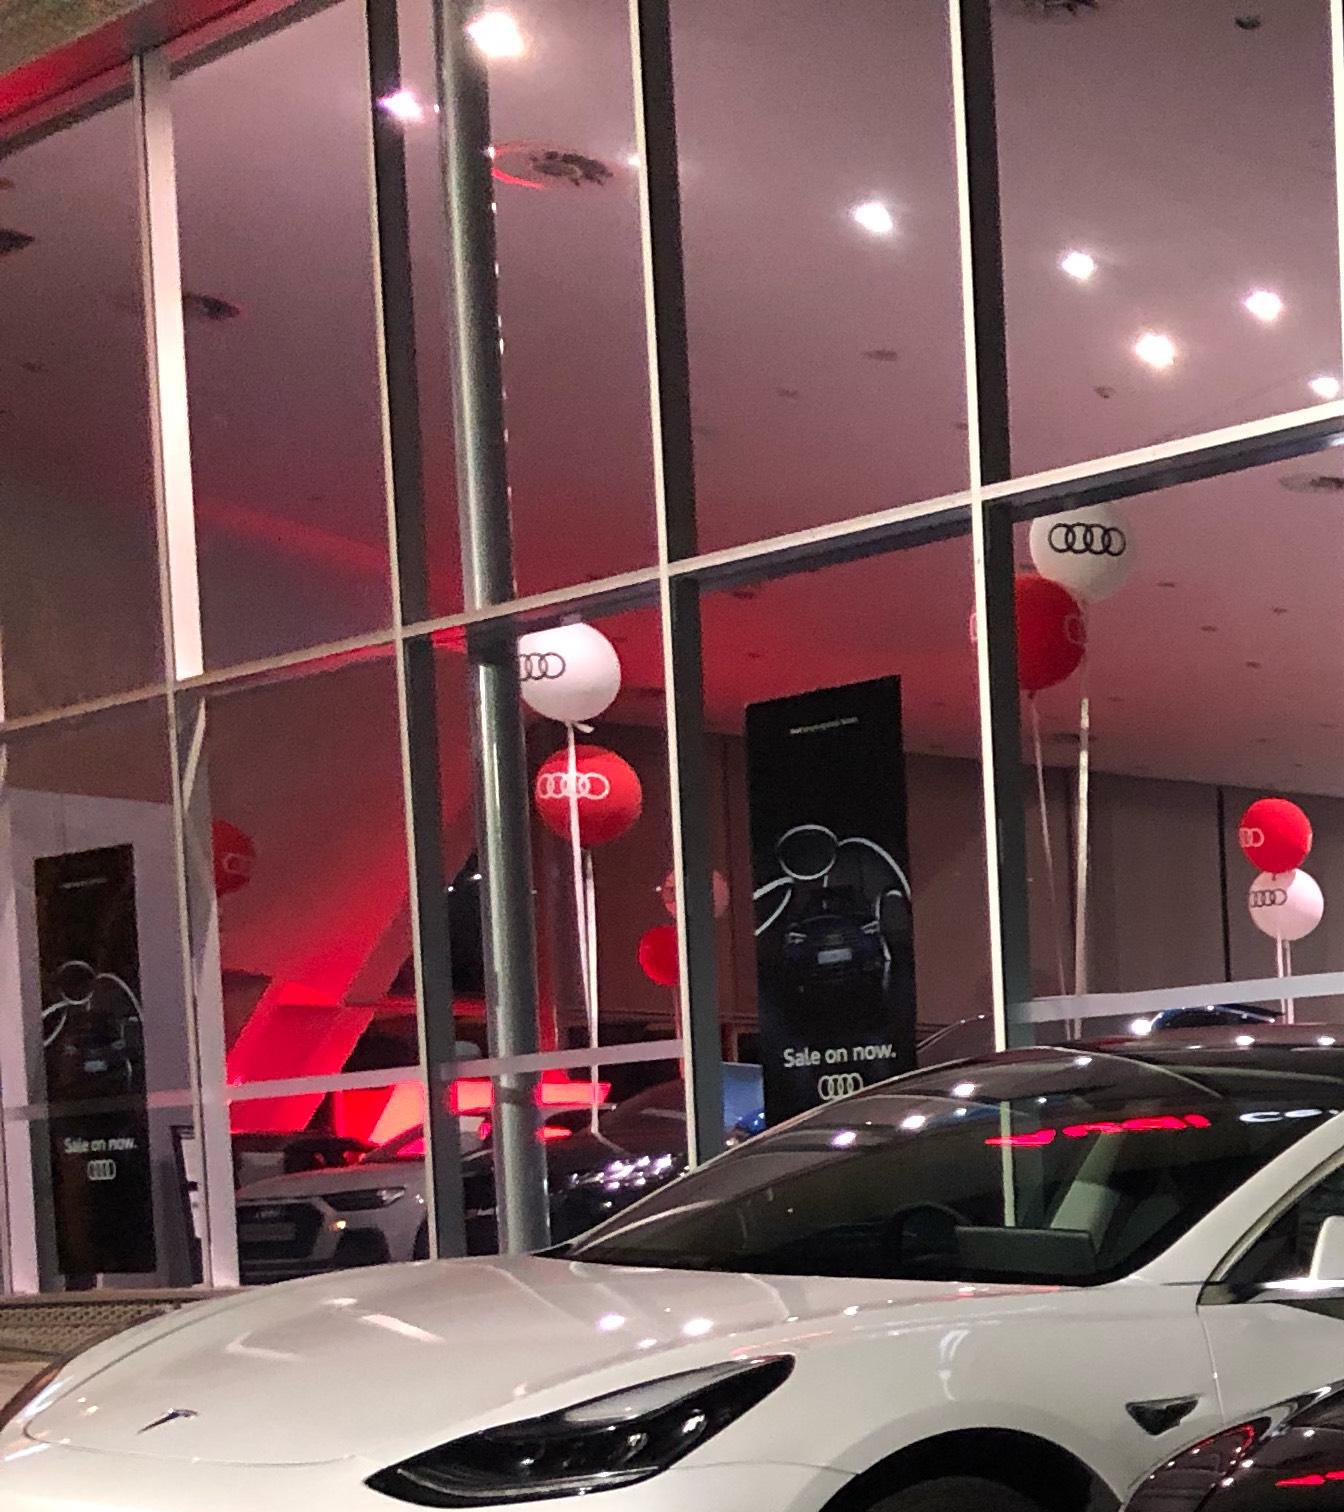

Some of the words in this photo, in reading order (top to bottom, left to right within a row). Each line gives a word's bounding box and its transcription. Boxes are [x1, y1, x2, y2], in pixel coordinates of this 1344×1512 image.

[783, 1047, 821, 1067] Sale
[825, 1048, 848, 1064] on
[852, 1044, 897, 1061] now.
[91, 1139, 106, 1152] on
